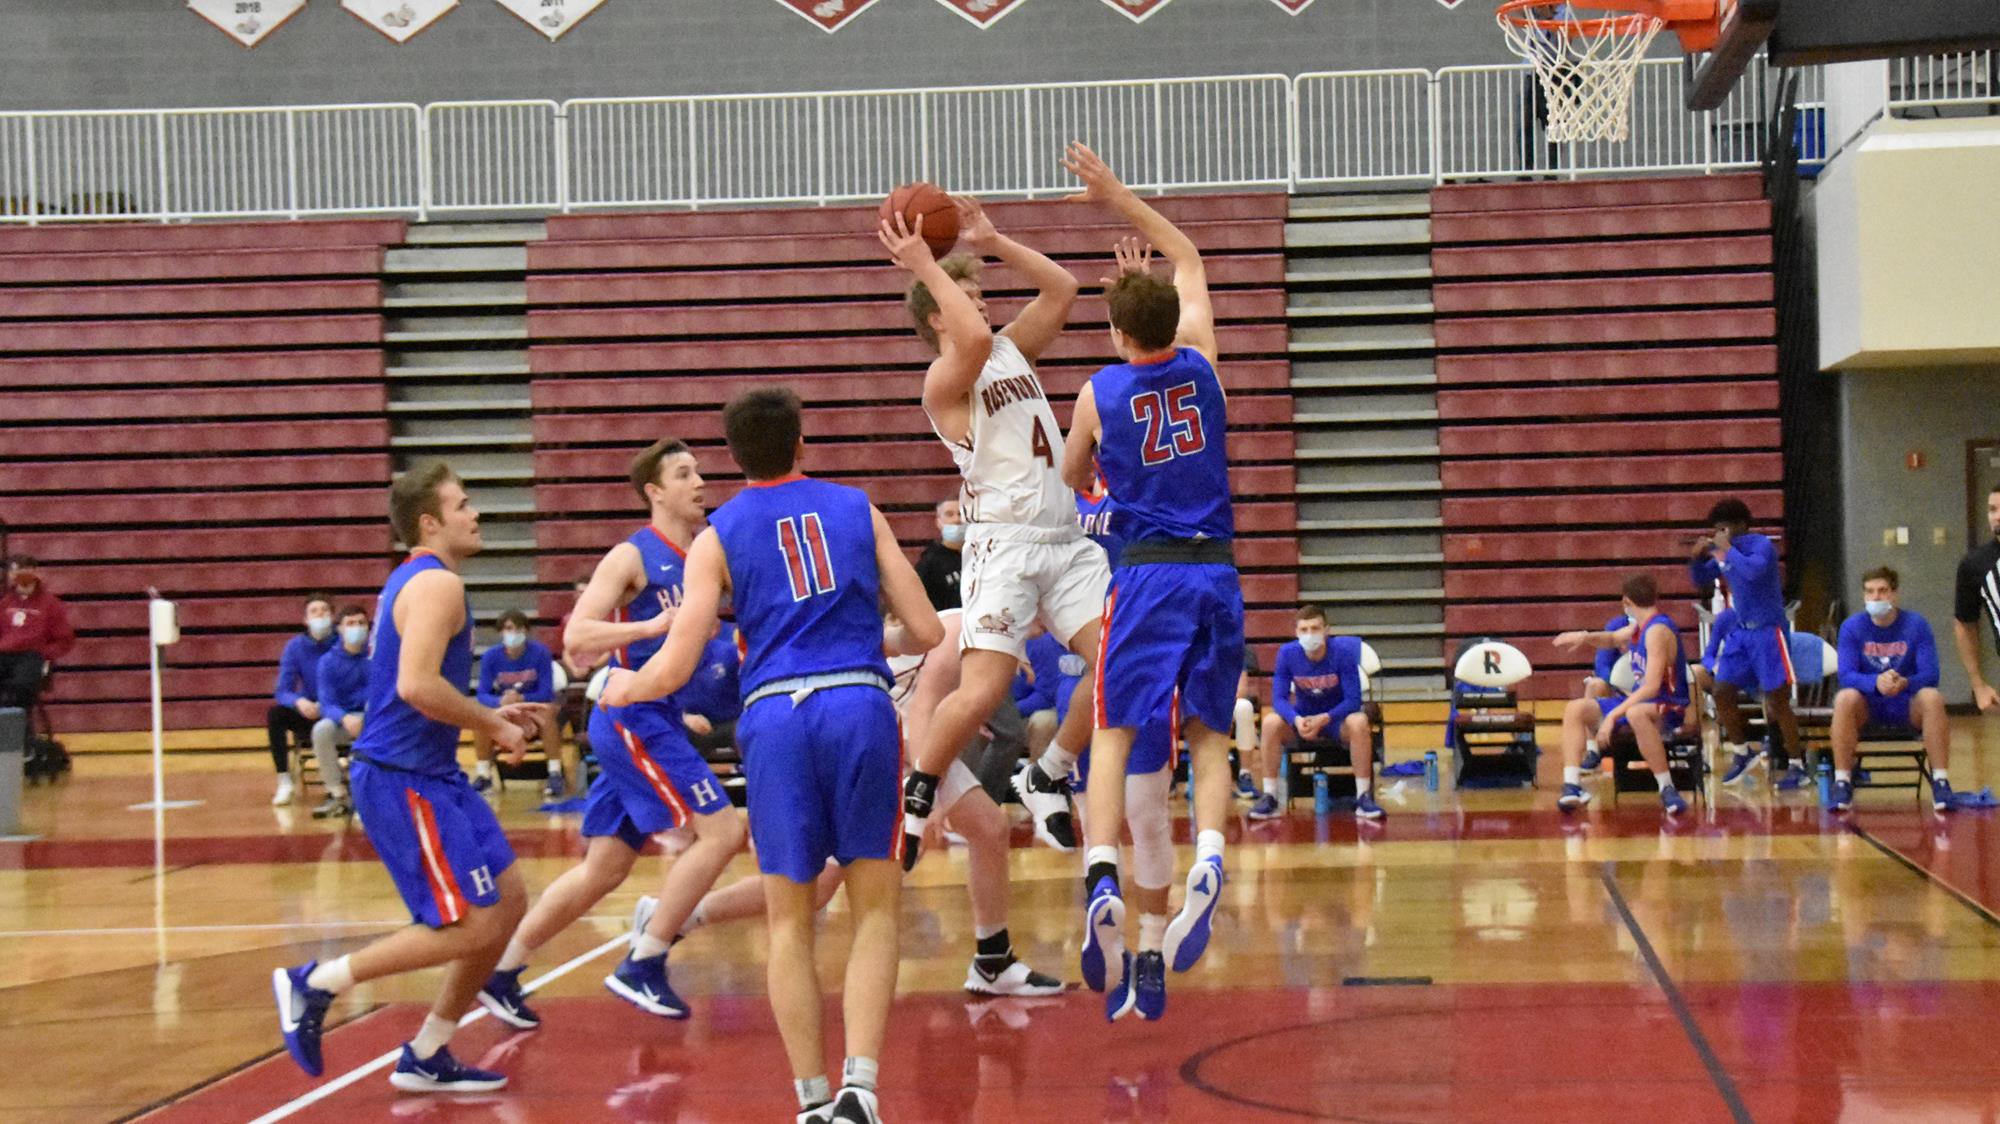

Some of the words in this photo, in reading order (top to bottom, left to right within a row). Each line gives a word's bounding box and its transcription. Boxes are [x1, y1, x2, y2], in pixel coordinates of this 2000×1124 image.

[1032, 414, 1055, 469] 4
[1130, 380, 1206, 467] 25
[776, 512, 836, 603] 11
[1484, 650, 1502, 674] R
[690, 778, 719, 807] H
[470, 864, 496, 897] H
